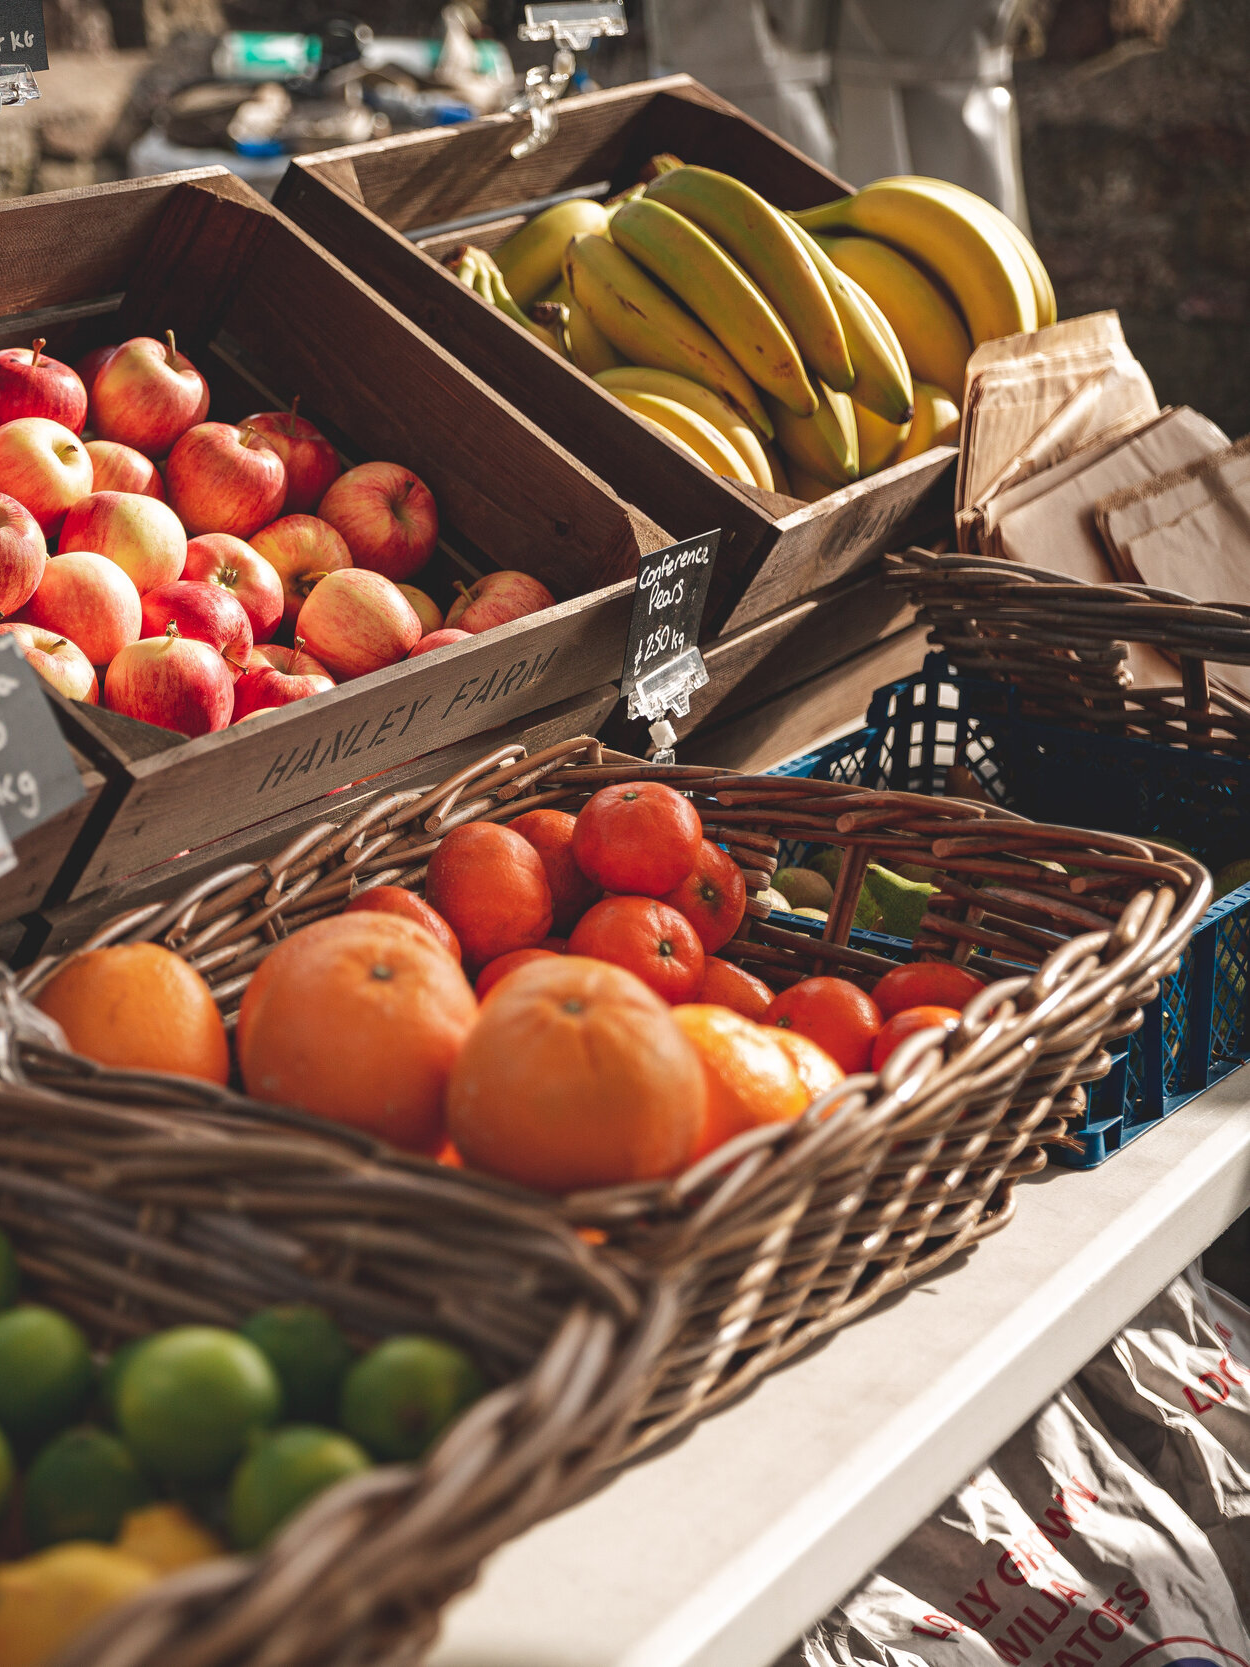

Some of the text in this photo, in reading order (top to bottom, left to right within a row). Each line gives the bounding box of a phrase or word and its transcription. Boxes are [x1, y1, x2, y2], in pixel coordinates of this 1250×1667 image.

[639, 546, 709, 590] Conference
[648, 578, 684, 615] Pears
[256, 645, 560, 794] HANLEY FARM
[996, 1475, 1099, 1587] GROWN
[992, 1580, 1086, 1666] WILJA
